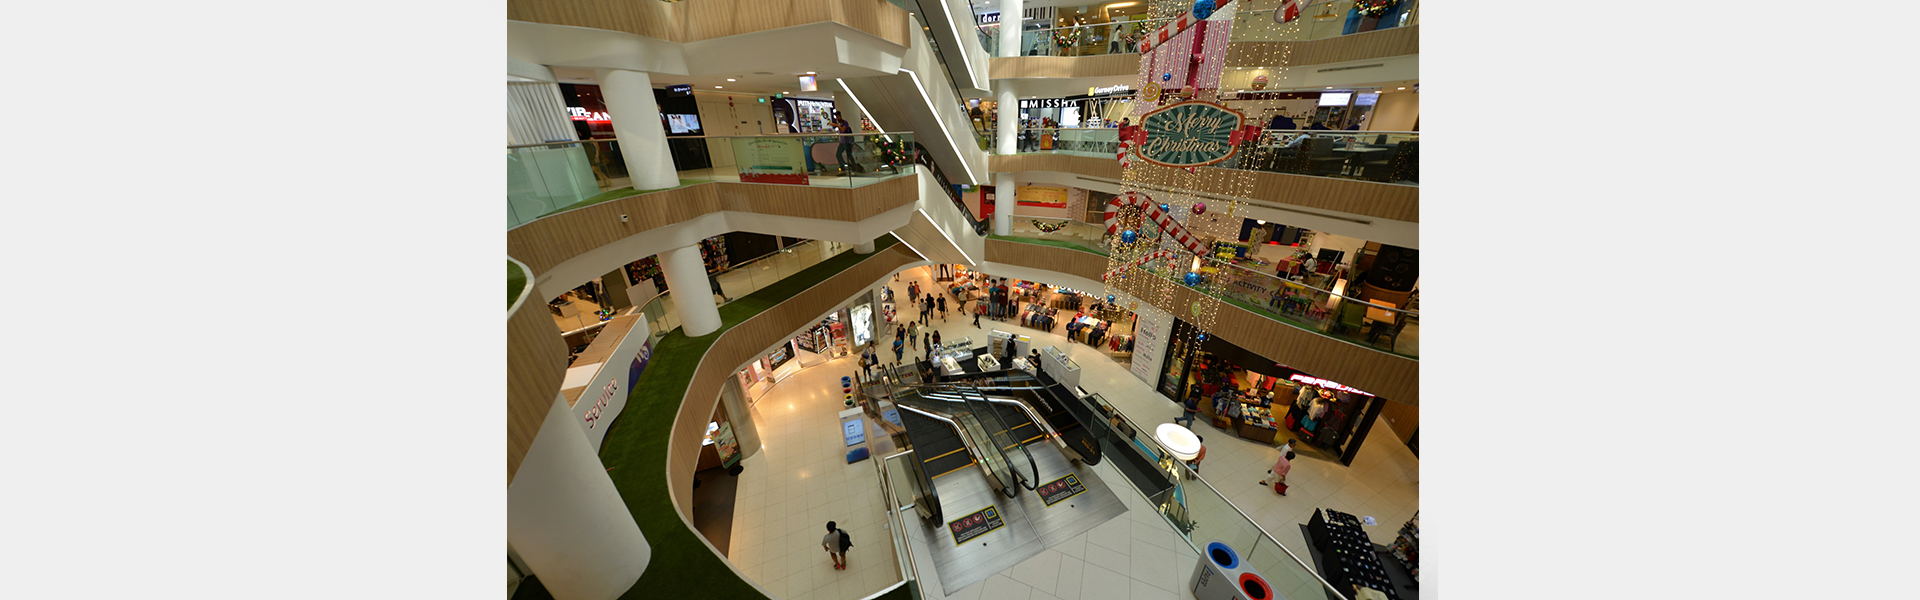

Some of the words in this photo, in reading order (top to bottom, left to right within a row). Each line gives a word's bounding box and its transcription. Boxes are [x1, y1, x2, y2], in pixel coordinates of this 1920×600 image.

[1165, 112, 1223, 137] Merry
[1147, 136, 1223, 157] Christmas
[584, 378, 619, 430] Service
